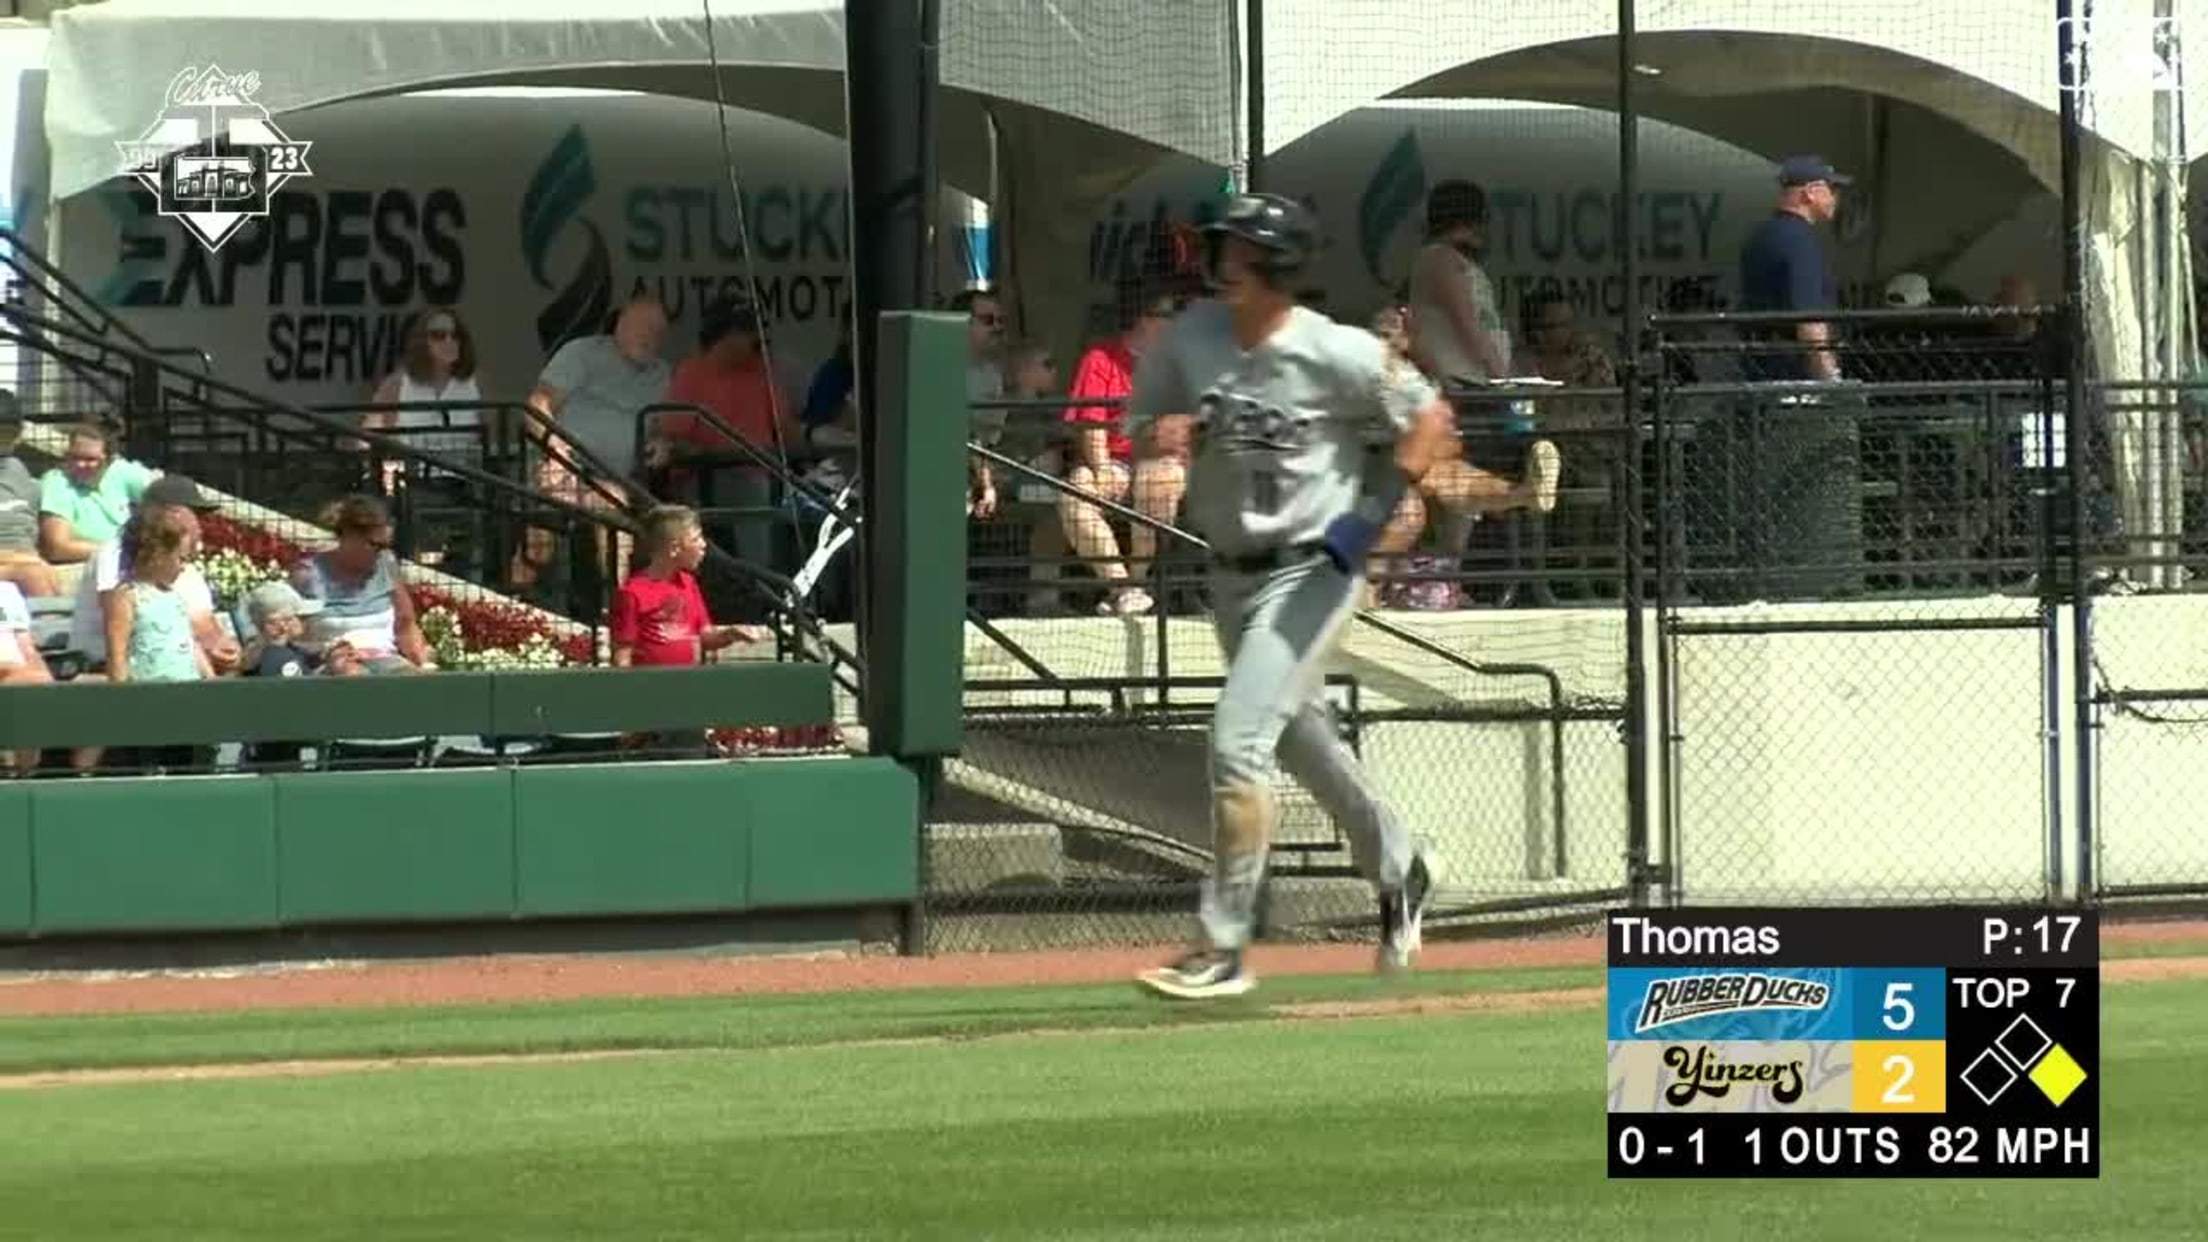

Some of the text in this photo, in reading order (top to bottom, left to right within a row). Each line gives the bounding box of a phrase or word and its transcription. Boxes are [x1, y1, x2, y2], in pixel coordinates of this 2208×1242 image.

[112, 188, 466, 305] EXPRESS
[625, 186, 850, 262] STUCK
[1480, 191, 1722, 262] TUCKEY
[630, 275, 850, 322] AUTOMOT
